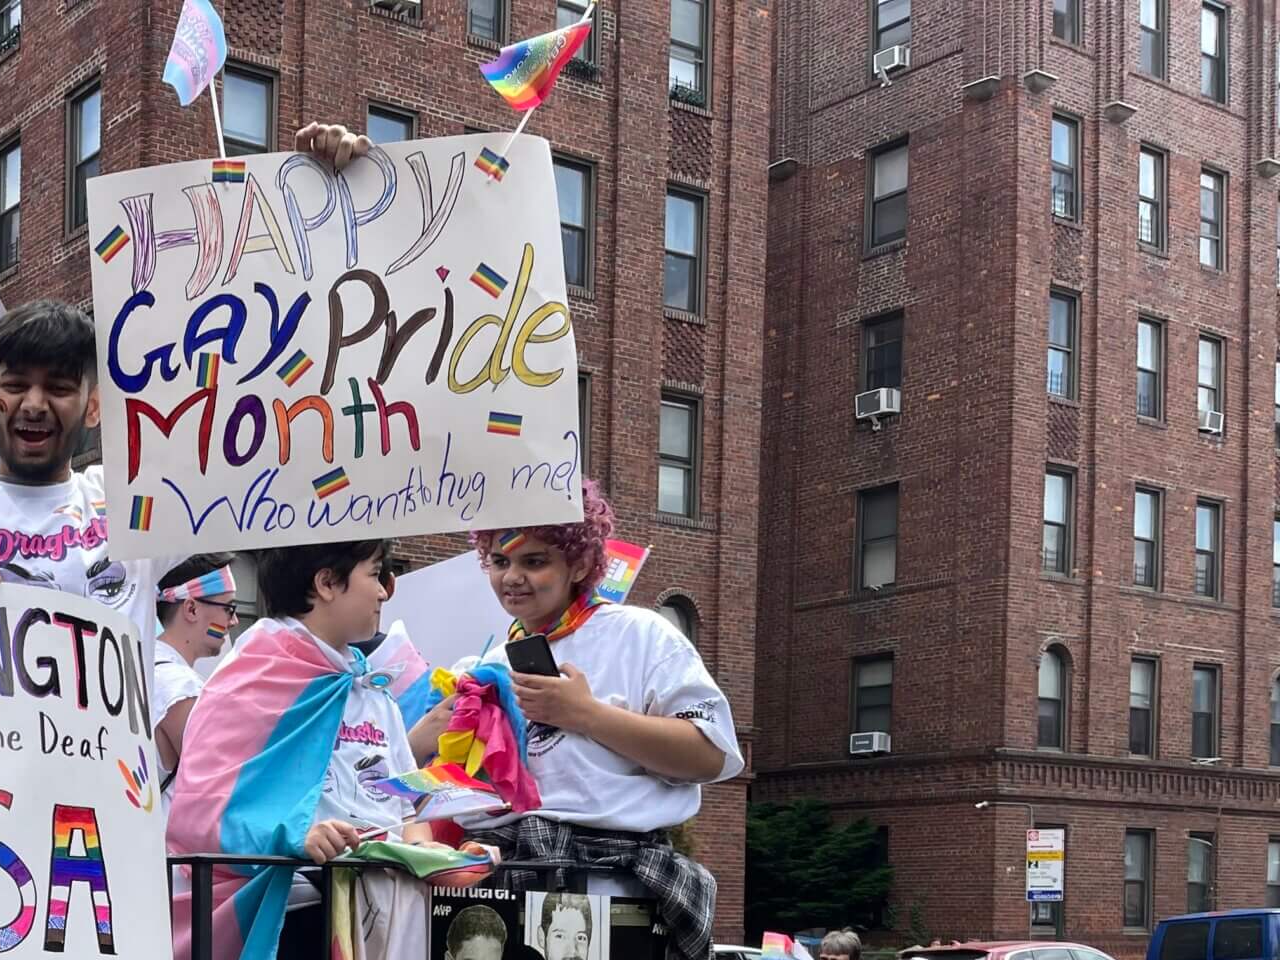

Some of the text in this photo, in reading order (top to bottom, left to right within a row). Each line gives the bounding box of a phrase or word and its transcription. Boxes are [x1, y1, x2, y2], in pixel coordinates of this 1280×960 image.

[118, 143, 466, 300] HAPPY
[320, 242, 571, 395] Pride
[125, 377, 420, 485] Month
[162, 467, 295, 535] Who
[436, 432, 486, 521] hug
[39, 711, 109, 761] Deaf
